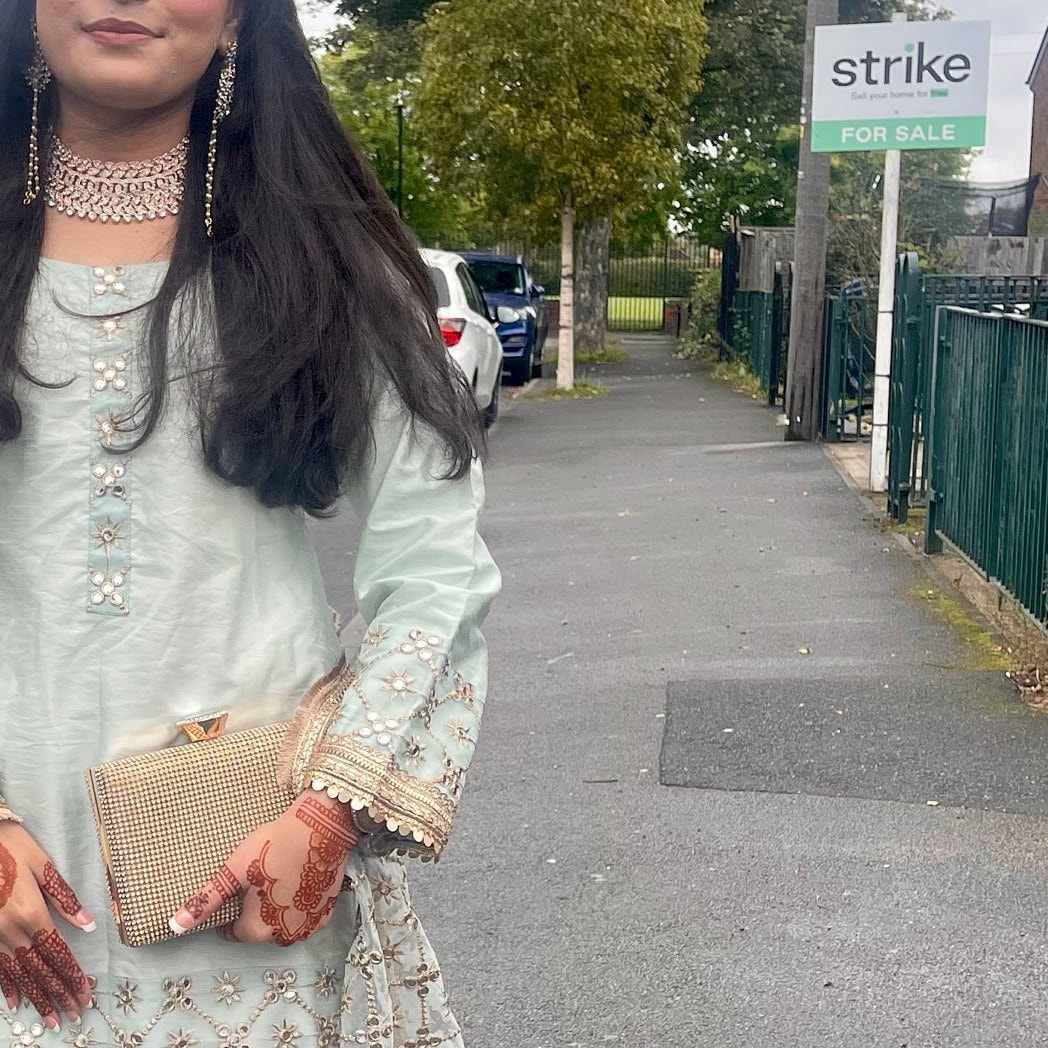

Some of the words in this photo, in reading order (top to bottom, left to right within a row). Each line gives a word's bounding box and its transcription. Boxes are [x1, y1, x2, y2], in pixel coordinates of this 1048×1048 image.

[832, 42, 971, 86] strike
[869, 92, 889, 101] your
[890, 90, 914, 99] home
[916, 89, 929, 98] for
[841, 126, 887, 143] FOR
[895, 124, 955, 141] SALE
